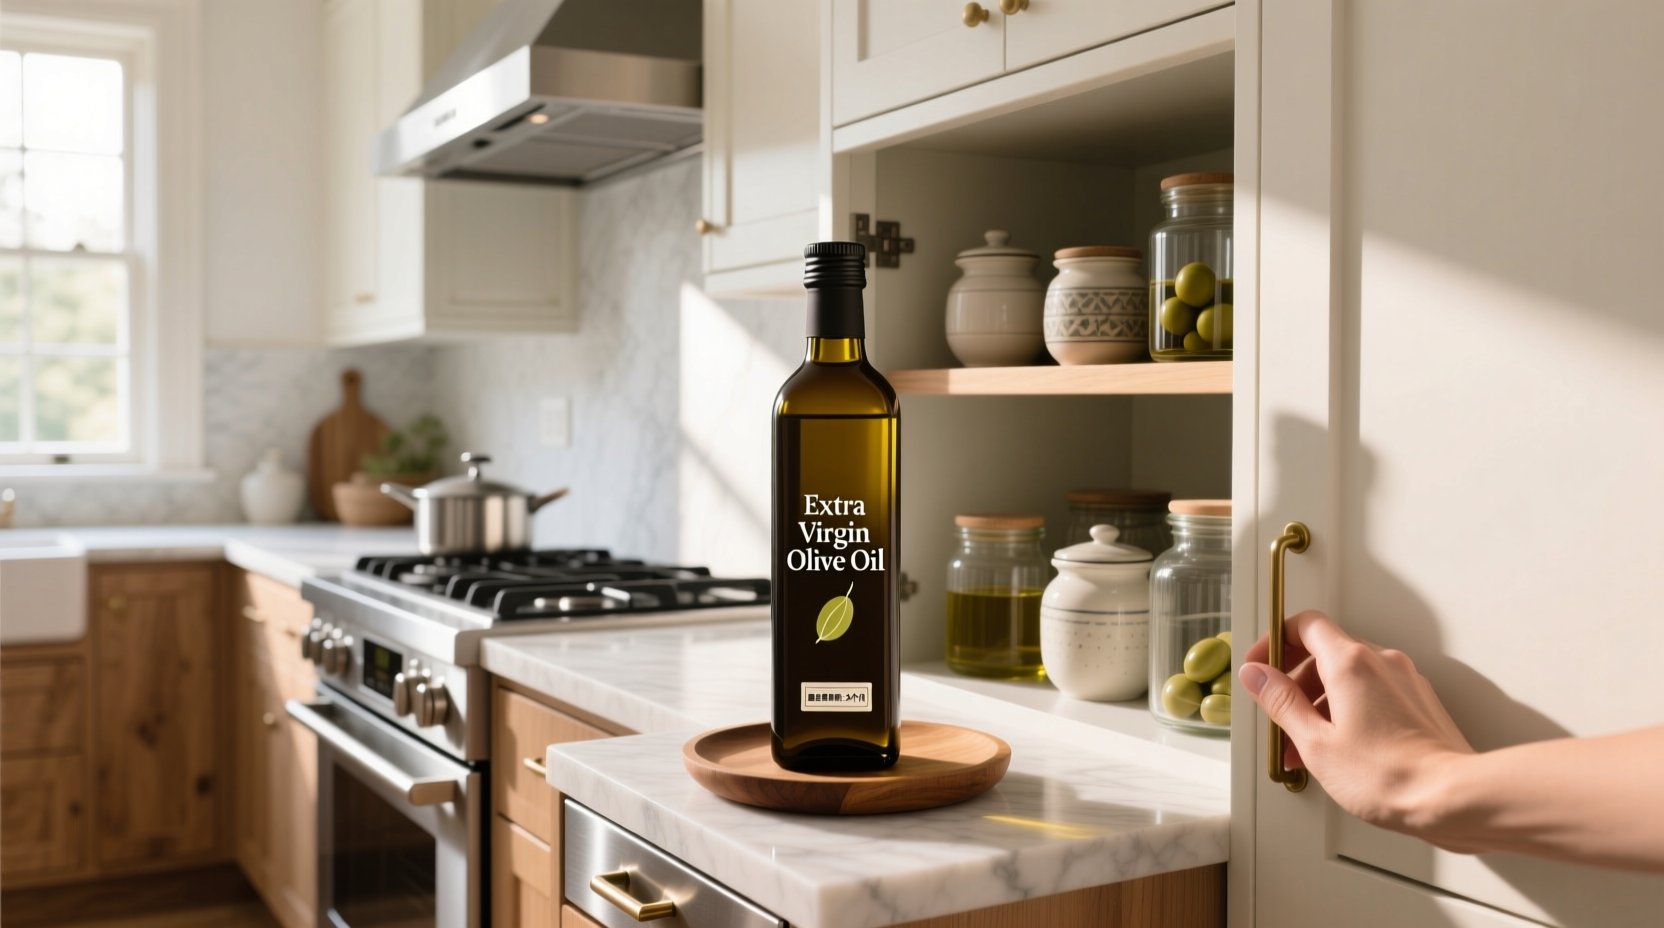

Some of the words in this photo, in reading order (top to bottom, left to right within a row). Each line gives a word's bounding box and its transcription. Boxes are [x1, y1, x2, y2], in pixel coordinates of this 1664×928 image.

[804, 494, 866, 516] Extra
[798, 521, 870, 550] Virgin
[787, 548, 846, 571] Olive
[850, 548, 885, 571] Oil
